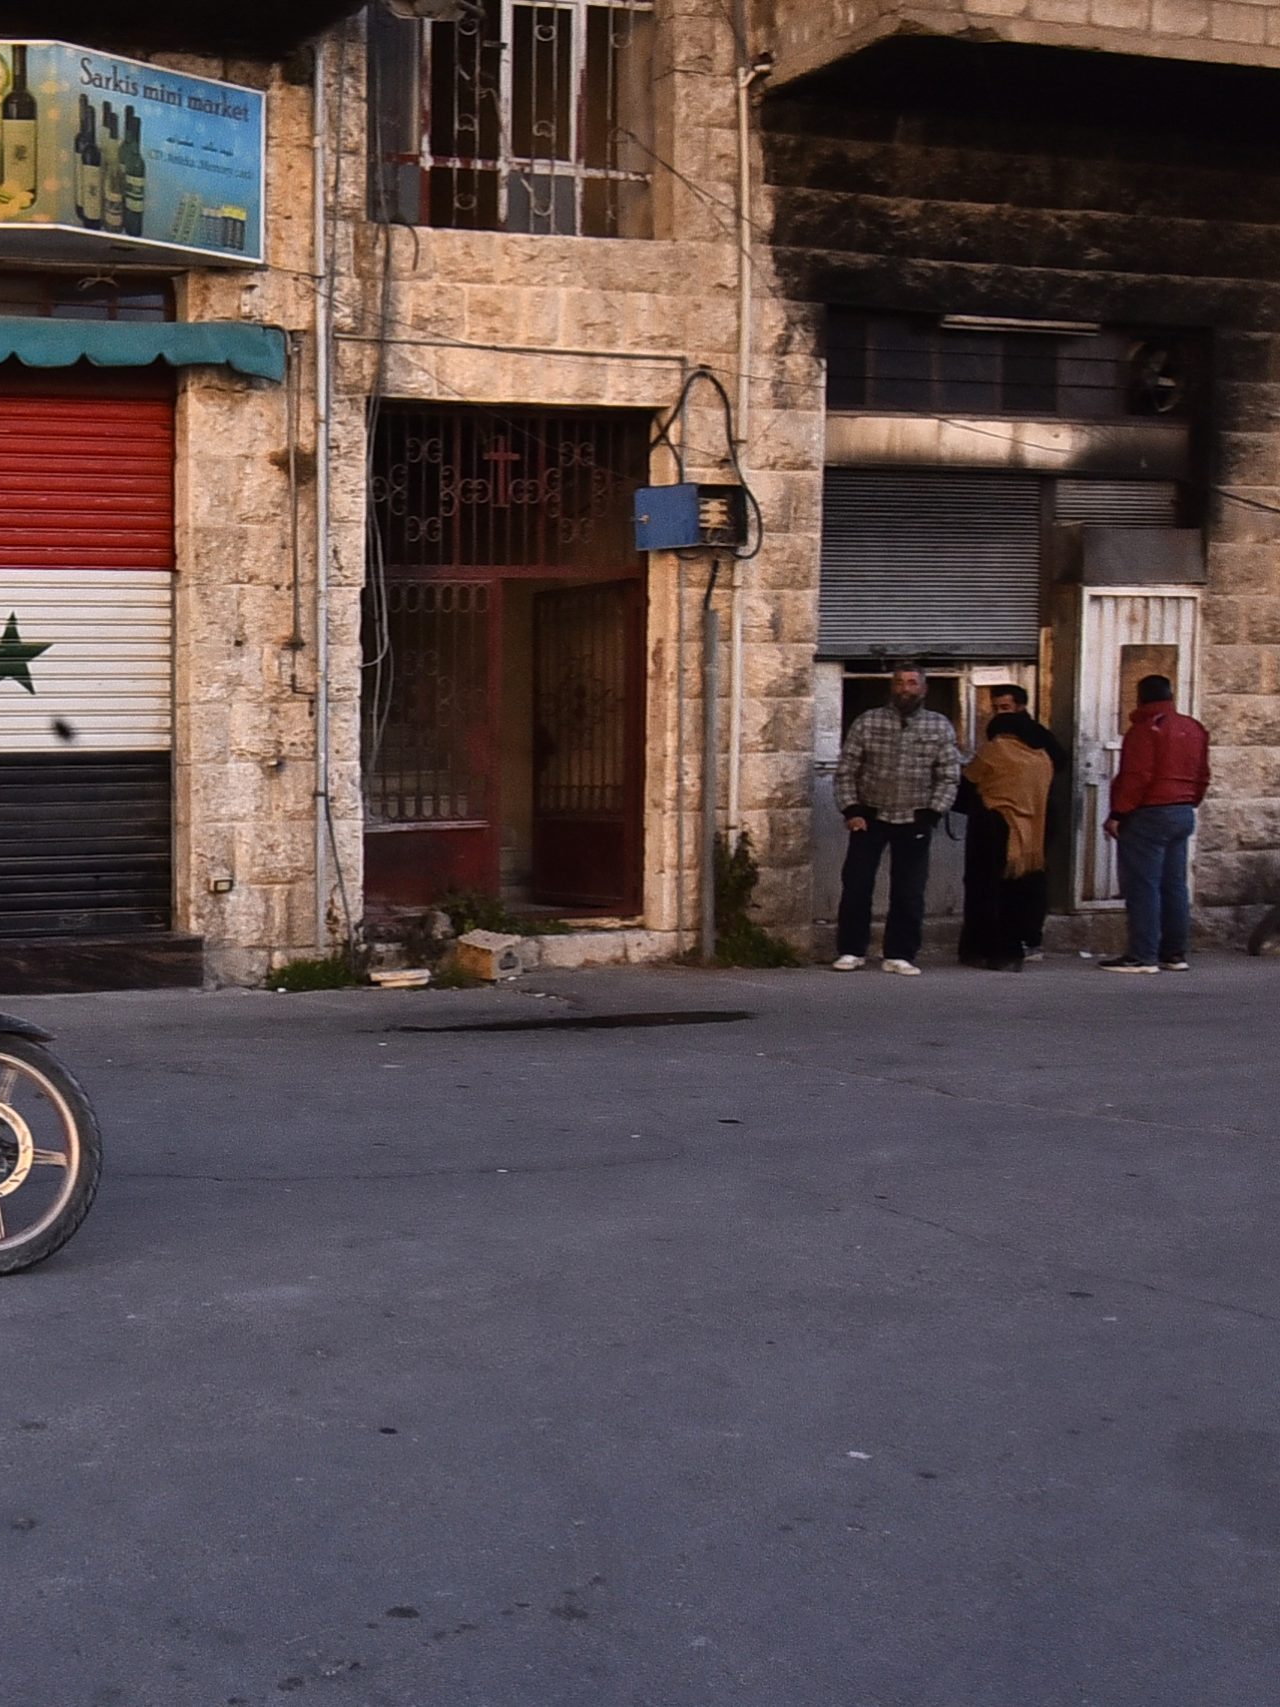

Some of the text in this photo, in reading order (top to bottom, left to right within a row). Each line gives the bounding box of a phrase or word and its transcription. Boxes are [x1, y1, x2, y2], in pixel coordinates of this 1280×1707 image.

[80, 57, 248, 122] Sarkis mini market
